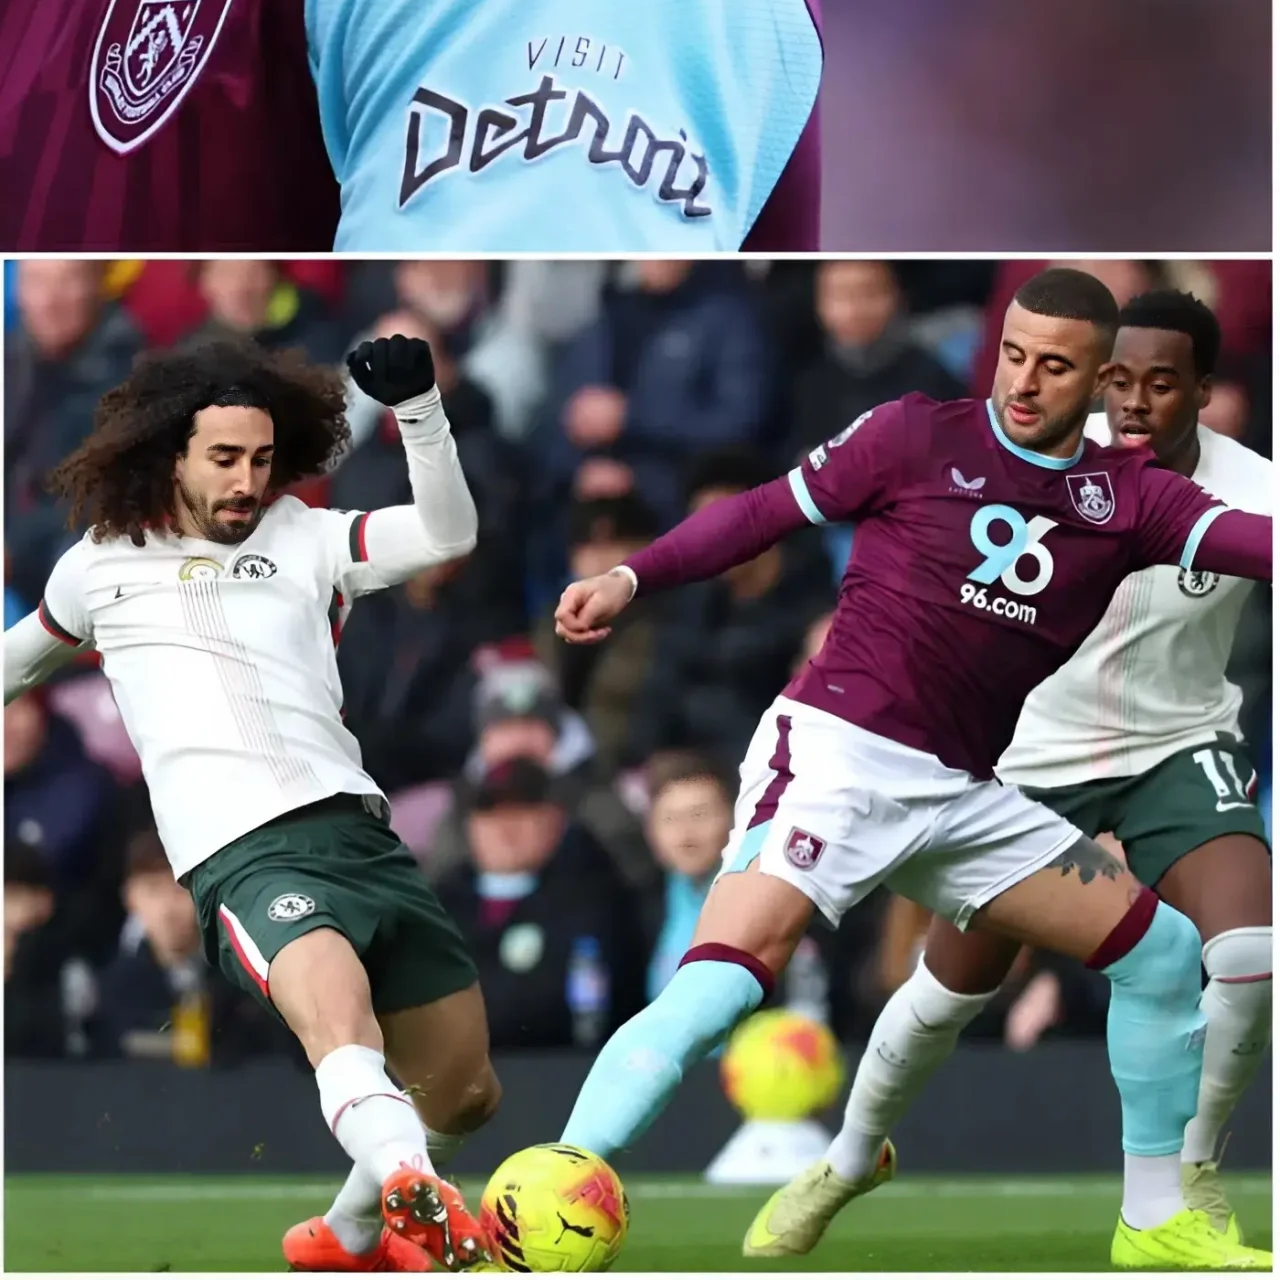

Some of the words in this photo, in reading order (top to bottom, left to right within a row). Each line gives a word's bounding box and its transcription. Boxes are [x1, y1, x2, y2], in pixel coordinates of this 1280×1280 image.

[528, 36, 626, 80] VISIT
[966, 504, 1059, 596] 96
[960, 583, 1037, 625] 96.com
[1192, 748, 1247, 800] 11
